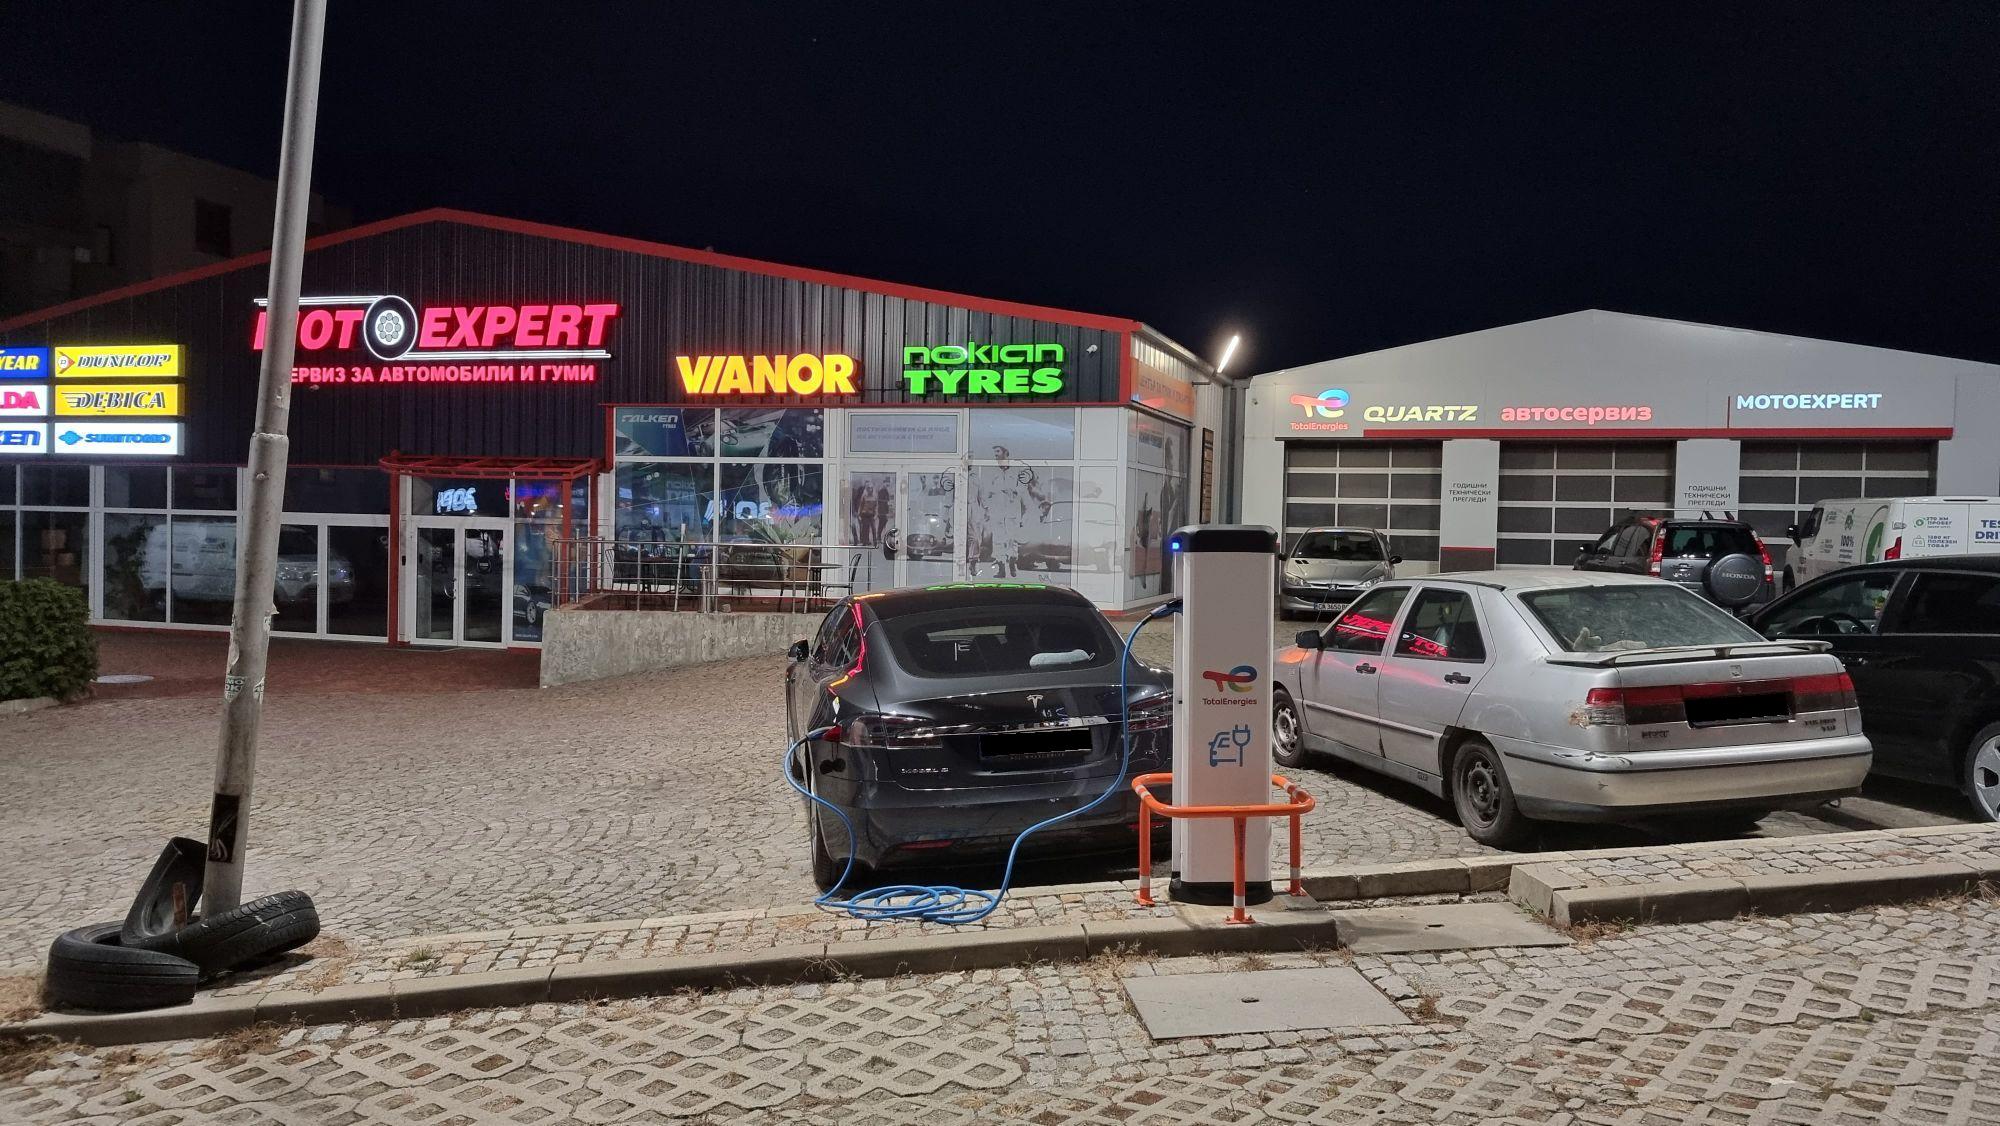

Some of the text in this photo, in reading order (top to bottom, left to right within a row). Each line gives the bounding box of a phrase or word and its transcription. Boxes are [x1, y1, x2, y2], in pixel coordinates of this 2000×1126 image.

[418, 304, 618, 348] EXPERT
[77, 354, 171, 367] DUNLOP
[351, 366, 374, 382] ЗА
[379, 365, 514, 382] АВТОМОБИЛИ
[520, 365, 534, 381] И
[540, 364, 595, 381] ГУМИ
[676, 352, 856, 395] VIANOR
[904, 368, 1063, 395] TYRES
[1736, 393, 1883, 410] MOTOEXPERT
[621, 414, 678, 423] FALKEN
[1363, 405, 1478, 422] QUARTZ
[1501, 405, 1653, 424] автосервиз
[1290, 422, 1349, 432] TotalEnergies
[1975, 531, 2000, 540] DRI
[1721, 572, 1756, 580] HONDA
[1202, 697, 1257, 706] TotalEnergies
